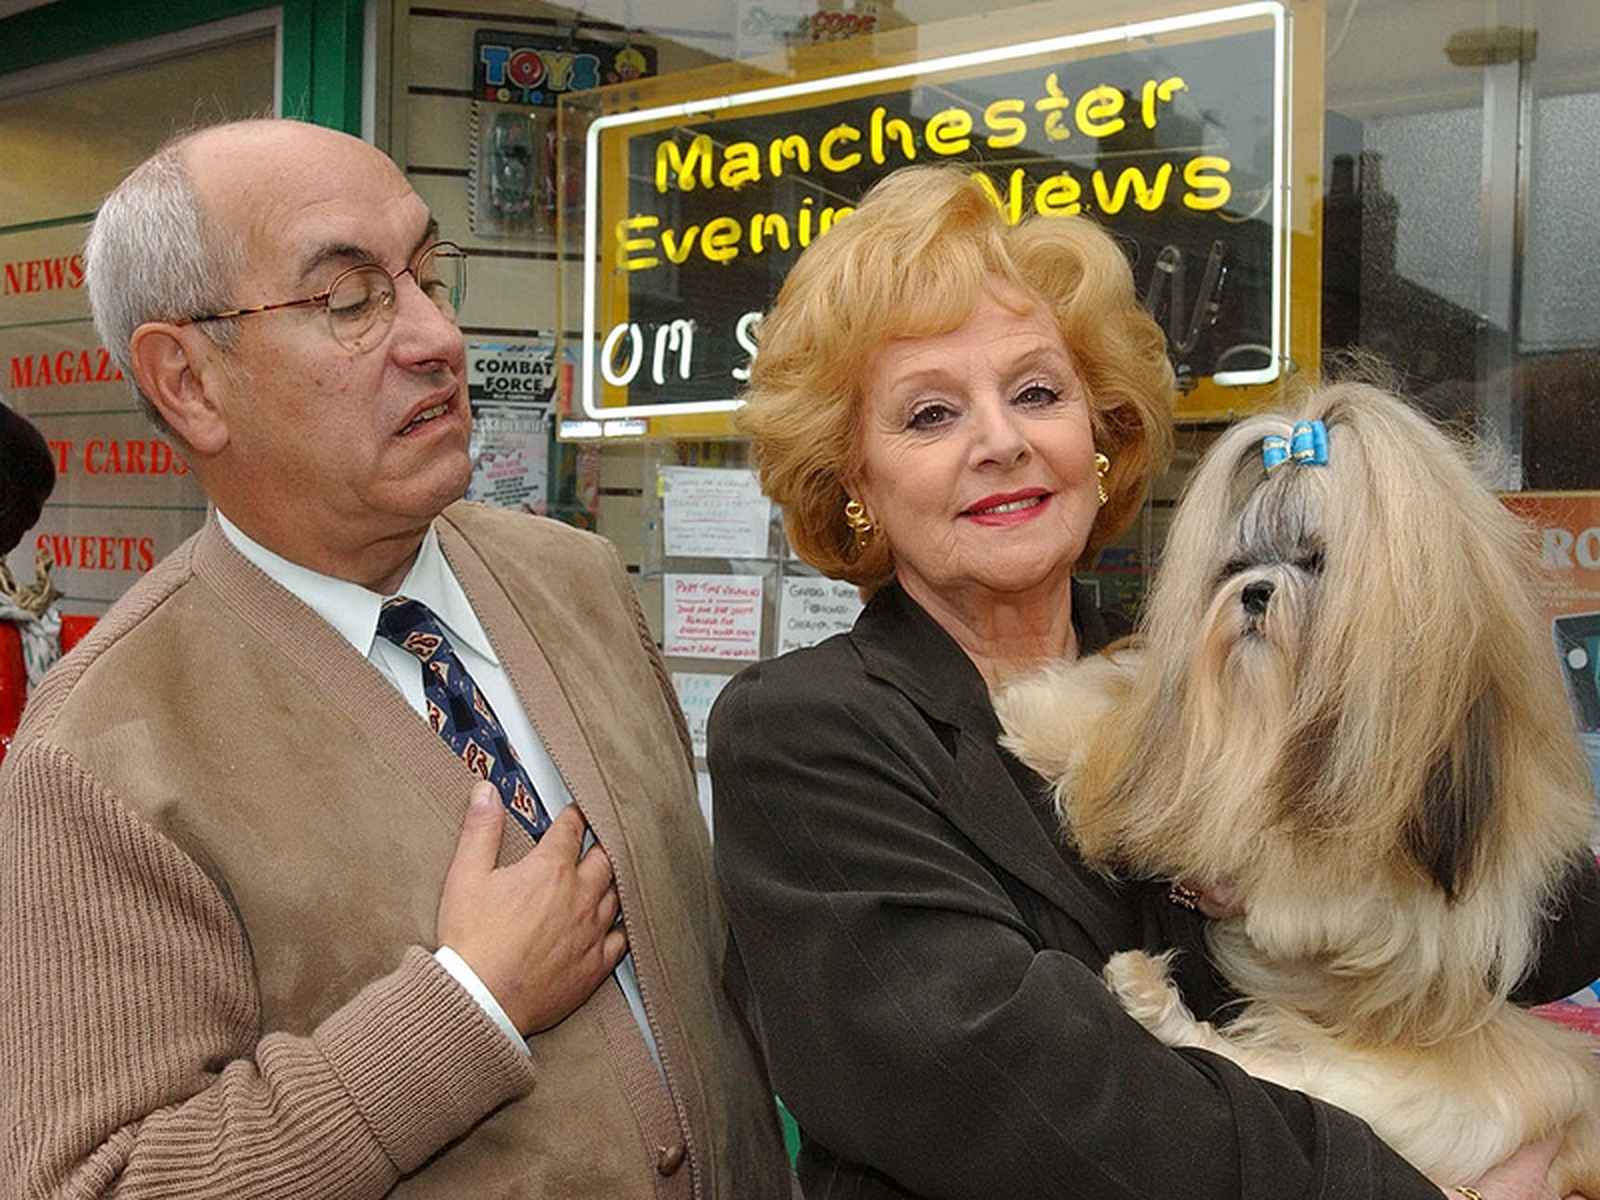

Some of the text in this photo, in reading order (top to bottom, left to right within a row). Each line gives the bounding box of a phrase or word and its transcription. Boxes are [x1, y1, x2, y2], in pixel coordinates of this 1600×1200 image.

[481, 46, 600, 92] TOYS
[654, 73, 1188, 194] Manchester
[614, 197, 856, 271] Evenin
[9, 347, 123, 389] MAGAZ
[475, 358, 553, 376] COMBAT
[485, 376, 544, 392] FORCE
[84, 439, 188, 475] CARDS
[36, 533, 154, 572] SWEETS
